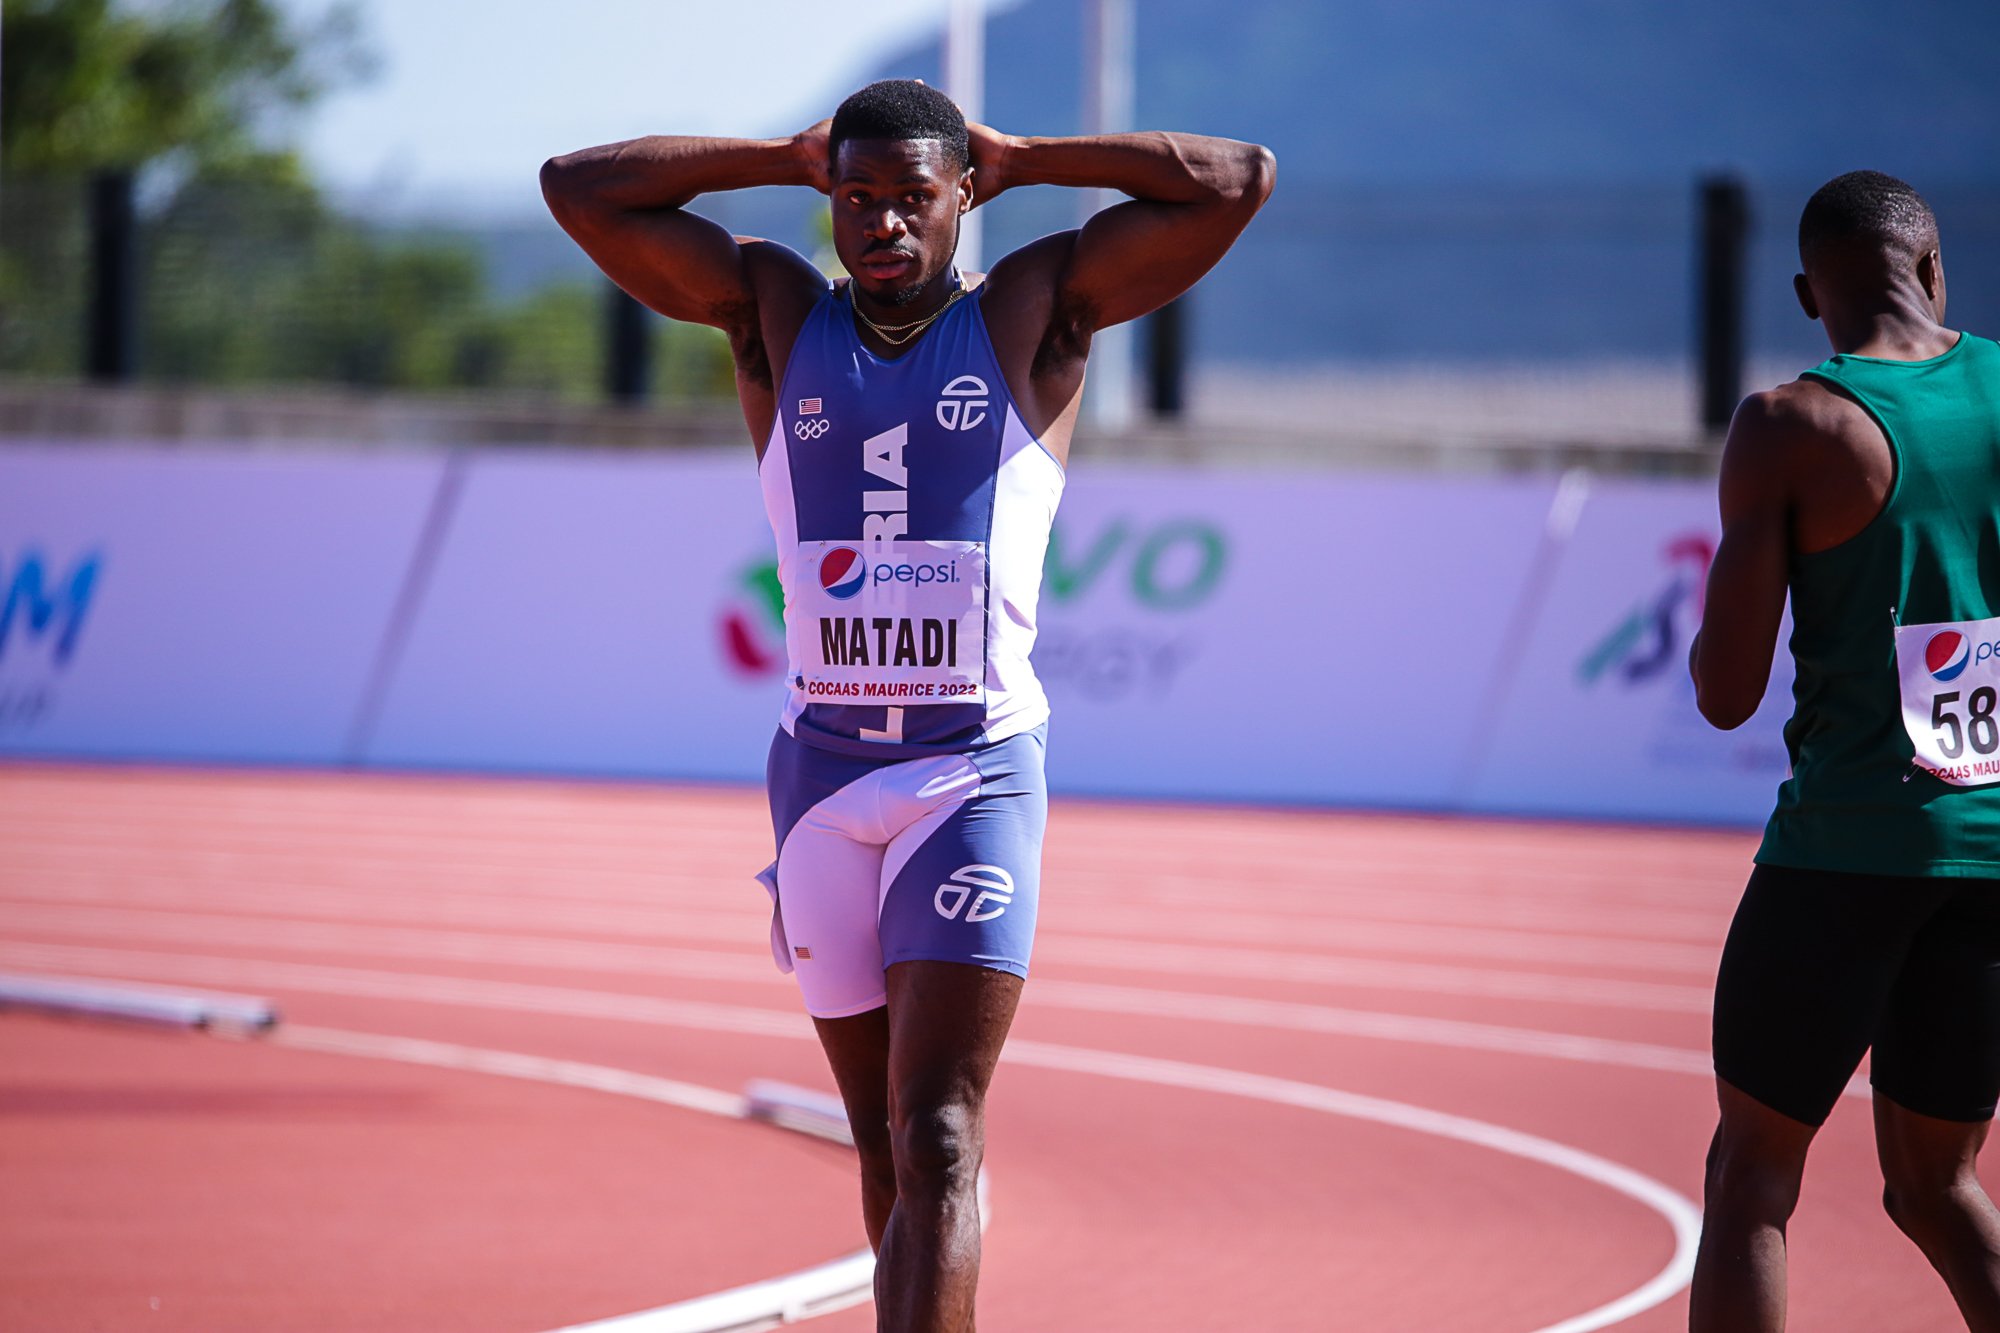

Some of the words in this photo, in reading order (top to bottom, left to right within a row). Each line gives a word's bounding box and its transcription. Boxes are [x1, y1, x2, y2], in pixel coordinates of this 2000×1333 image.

[819, 617, 957, 668] MATADI
[808, 681, 860, 696] COCAAS
[863, 683, 934, 697] MAURICE
[938, 683, 977, 697] 2022
[1931, 686, 1999, 759] 58
